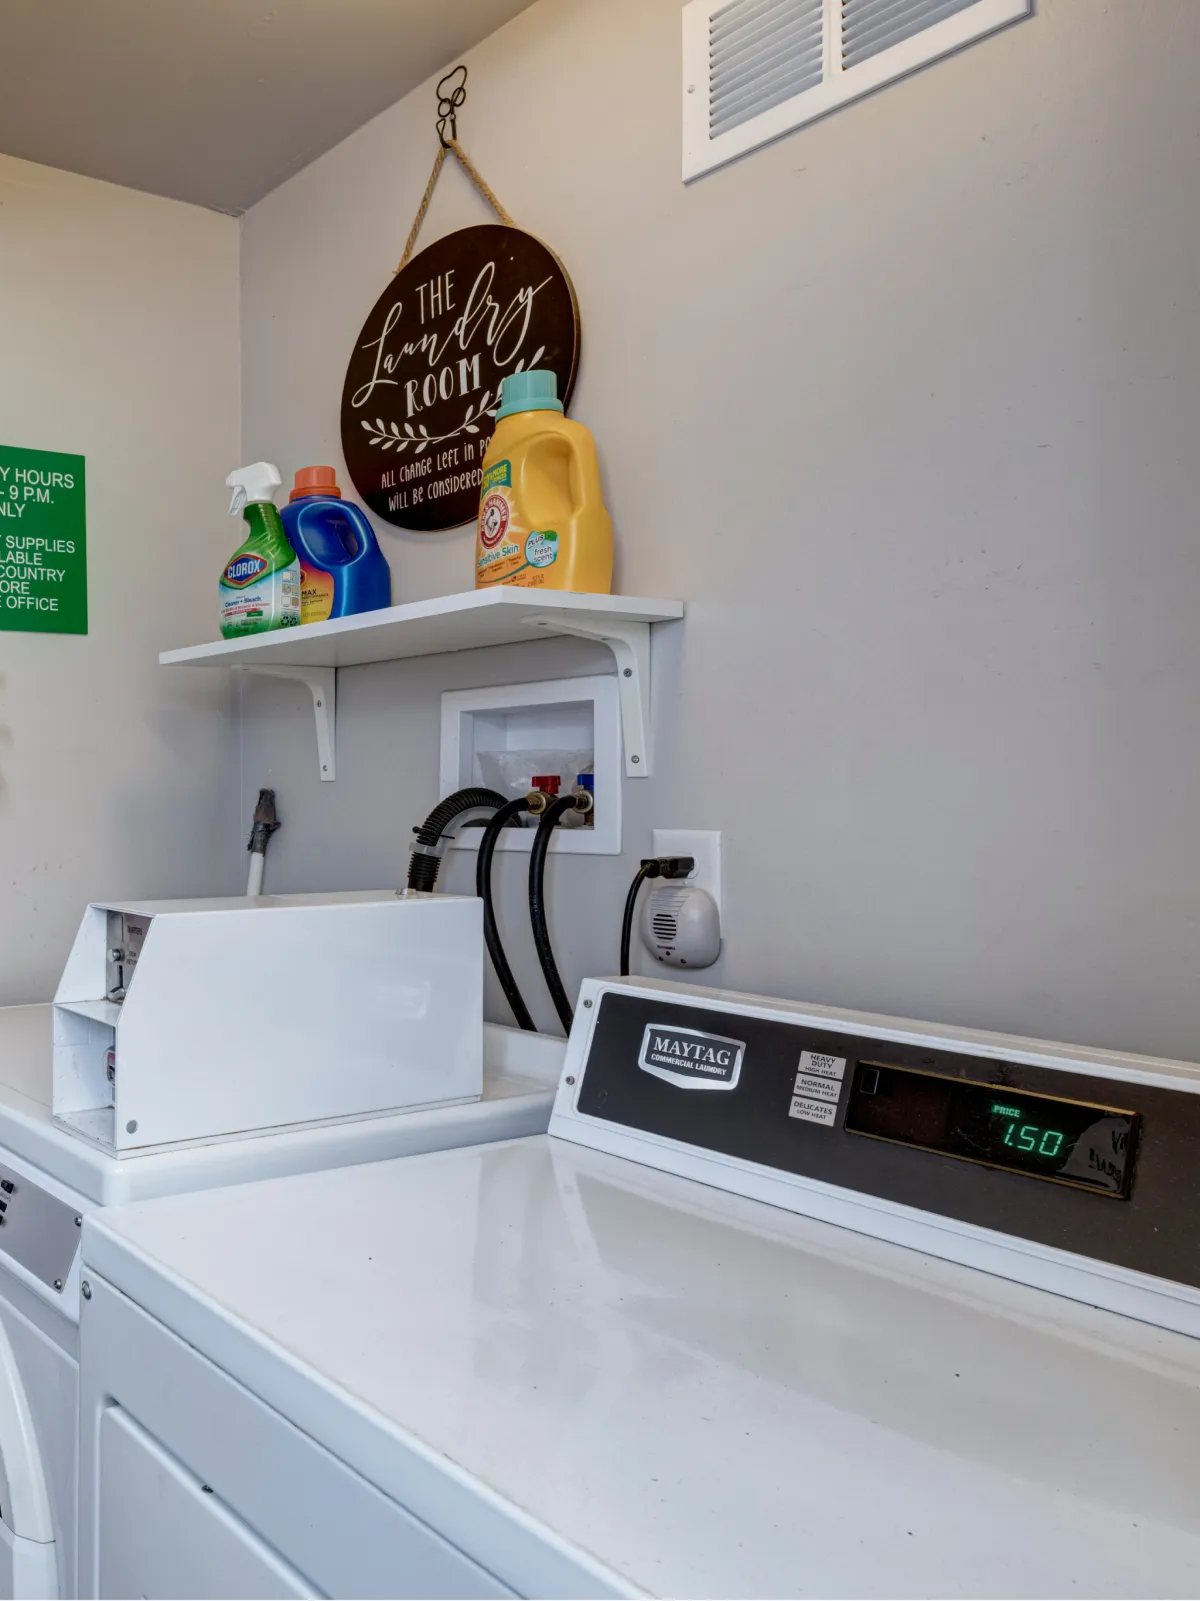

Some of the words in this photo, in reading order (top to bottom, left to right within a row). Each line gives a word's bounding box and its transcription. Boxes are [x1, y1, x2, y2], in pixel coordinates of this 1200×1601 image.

[415, 269, 455, 324] THE
[352, 261, 552, 407] Laundry
[404, 353, 482, 418] ROOM
[15, 468, 74, 489] HOURS
[381, 470, 396, 489] ALL
[9, 485, 19, 500] 9
[24, 487, 54, 504] P.M.
[6, 536, 75, 553] SUPPLIES
[528, 534, 544, 546] PLUS
[502, 545, 519, 556] Skin
[534, 553, 552, 562] scent
[535, 546, 552, 556] fresh
[227, 560, 260, 578] CLOROX
[6, 596, 58, 611] OFFICE
[653, 1036, 731, 1065] MAYTAG
[651, 1053, 694, 1069] COMMERCIAL
[695, 1062, 727, 1076] LAUNDRY
[810, 1054, 836, 1064] HEAVY
[811, 1060, 833, 1069] DUTY
[796, 1085, 820, 1094] MEDIUM
[801, 1079, 835, 1091] NORMAL
[794, 1101, 833, 1115] DELICATES
[993, 1105, 1020, 1118] PRICE
[1004, 1124, 1063, 1156] 1.50
